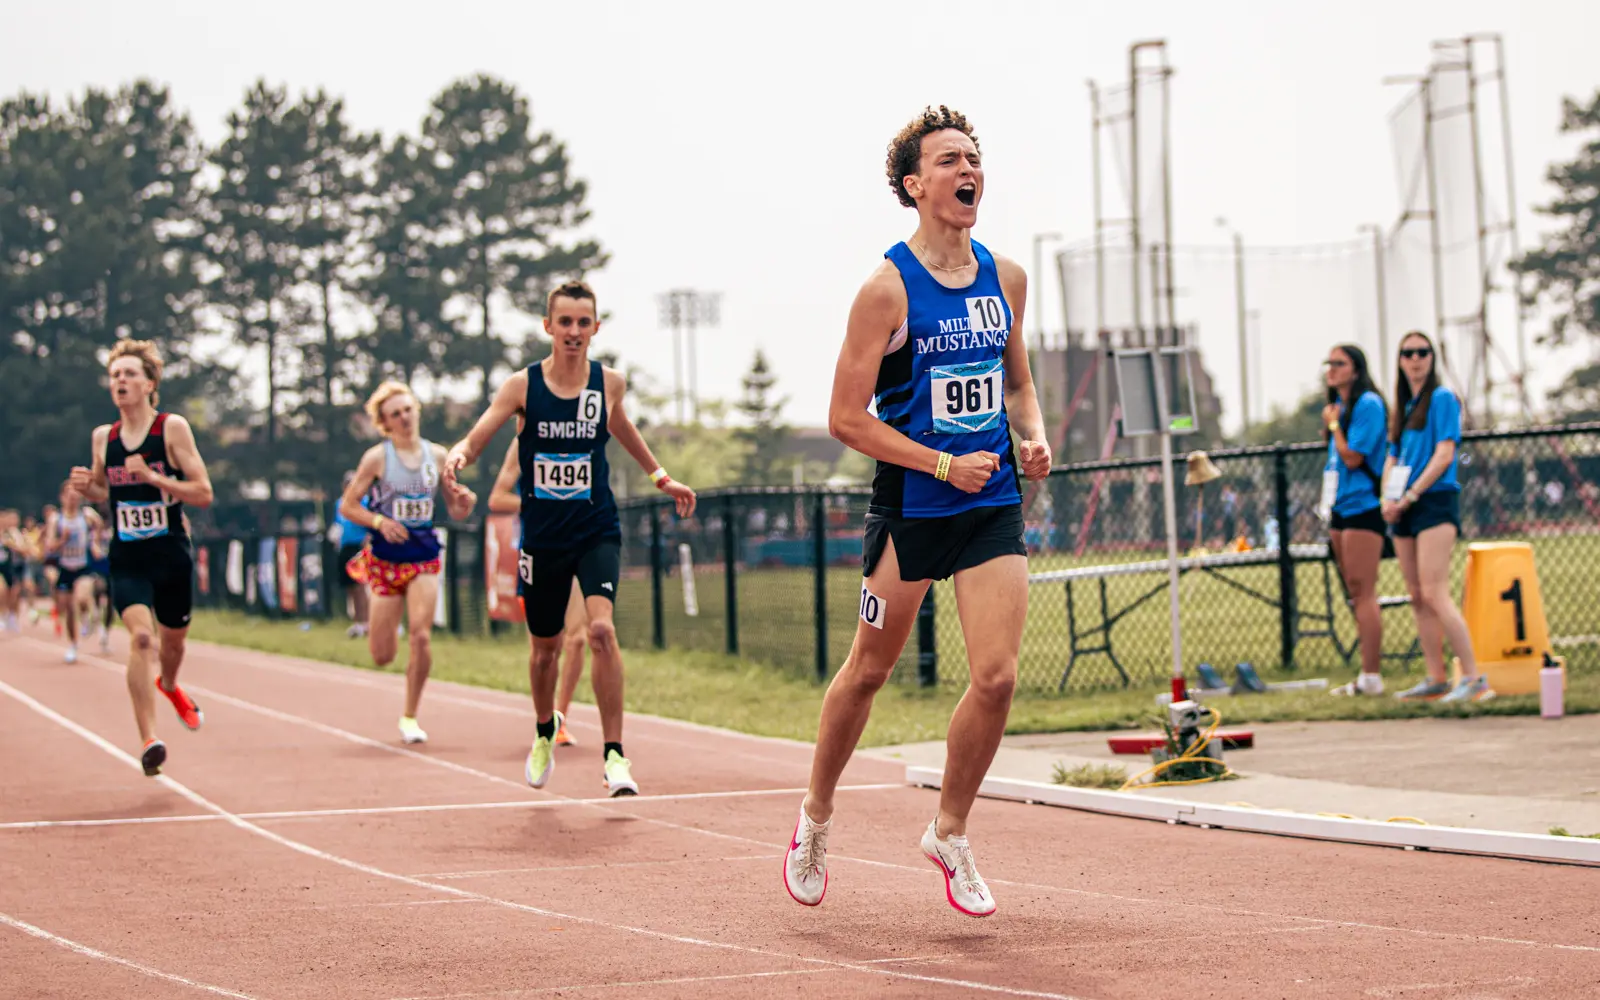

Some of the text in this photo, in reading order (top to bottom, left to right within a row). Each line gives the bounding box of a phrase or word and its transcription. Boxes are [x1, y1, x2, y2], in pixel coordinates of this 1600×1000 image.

[938, 316, 973, 334] MILT
[974, 298, 1001, 329] 10
[916, 330, 1009, 354] MUSTANGS
[584, 393, 598, 420] 6
[946, 376, 993, 415] 961
[538, 421, 597, 439] SMCHS
[537, 464, 589, 486] 1494
[121, 508, 164, 529] 1391
[861, 588, 879, 623] 10
[1501, 576, 1526, 641] 1
